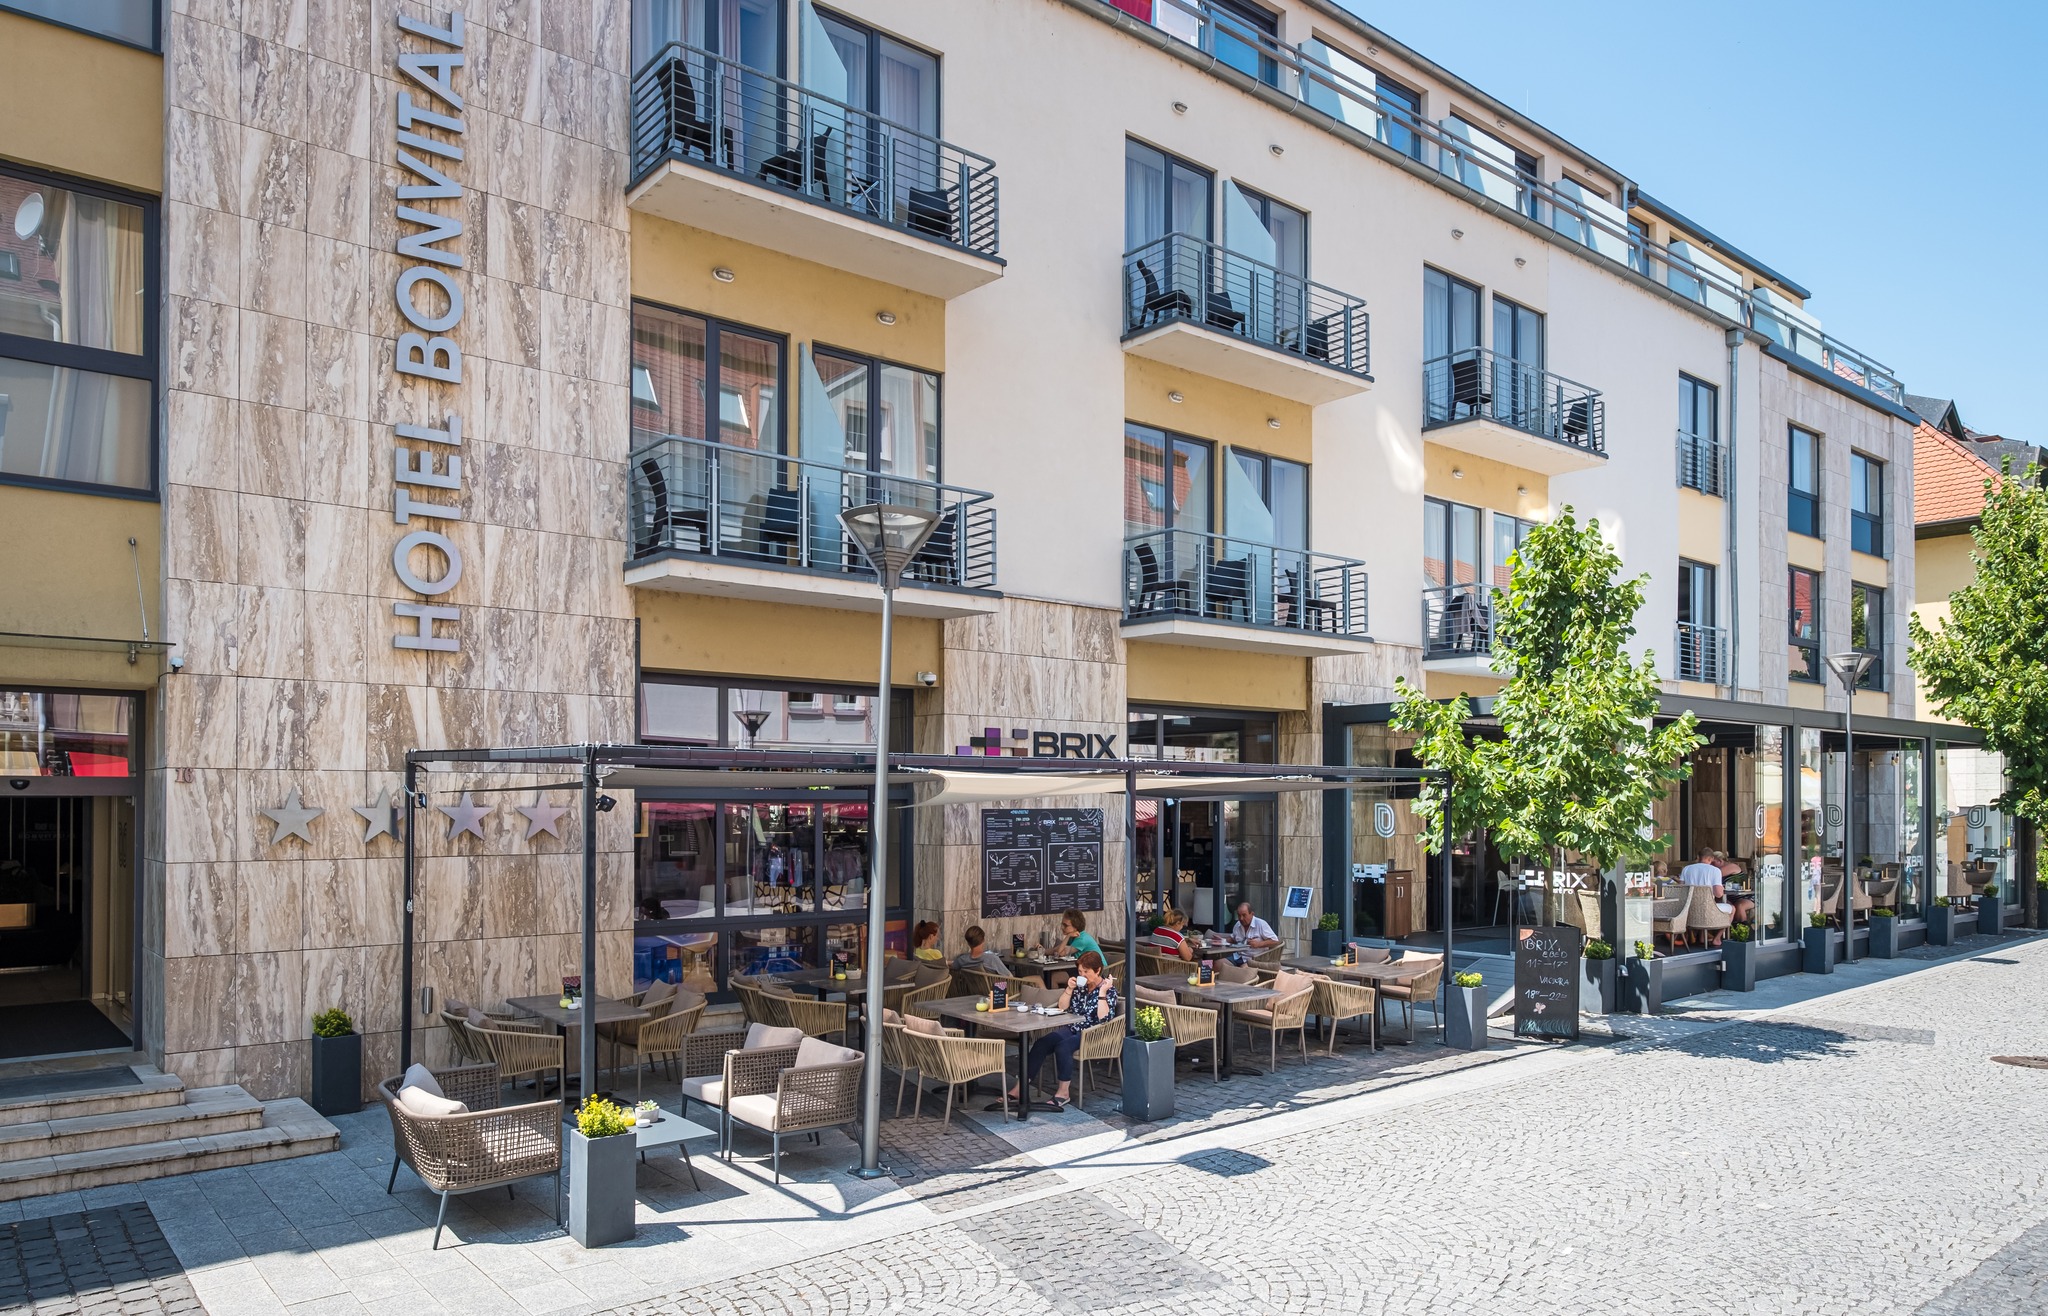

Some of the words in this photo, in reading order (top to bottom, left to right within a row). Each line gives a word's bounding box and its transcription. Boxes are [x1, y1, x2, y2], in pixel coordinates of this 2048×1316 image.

[396, 12, 464, 384] BONVITAL
[394, 415, 462, 652] HOTEL
[174, 767, 195, 784] 16
[1033, 731, 1117, 759] BRIX
